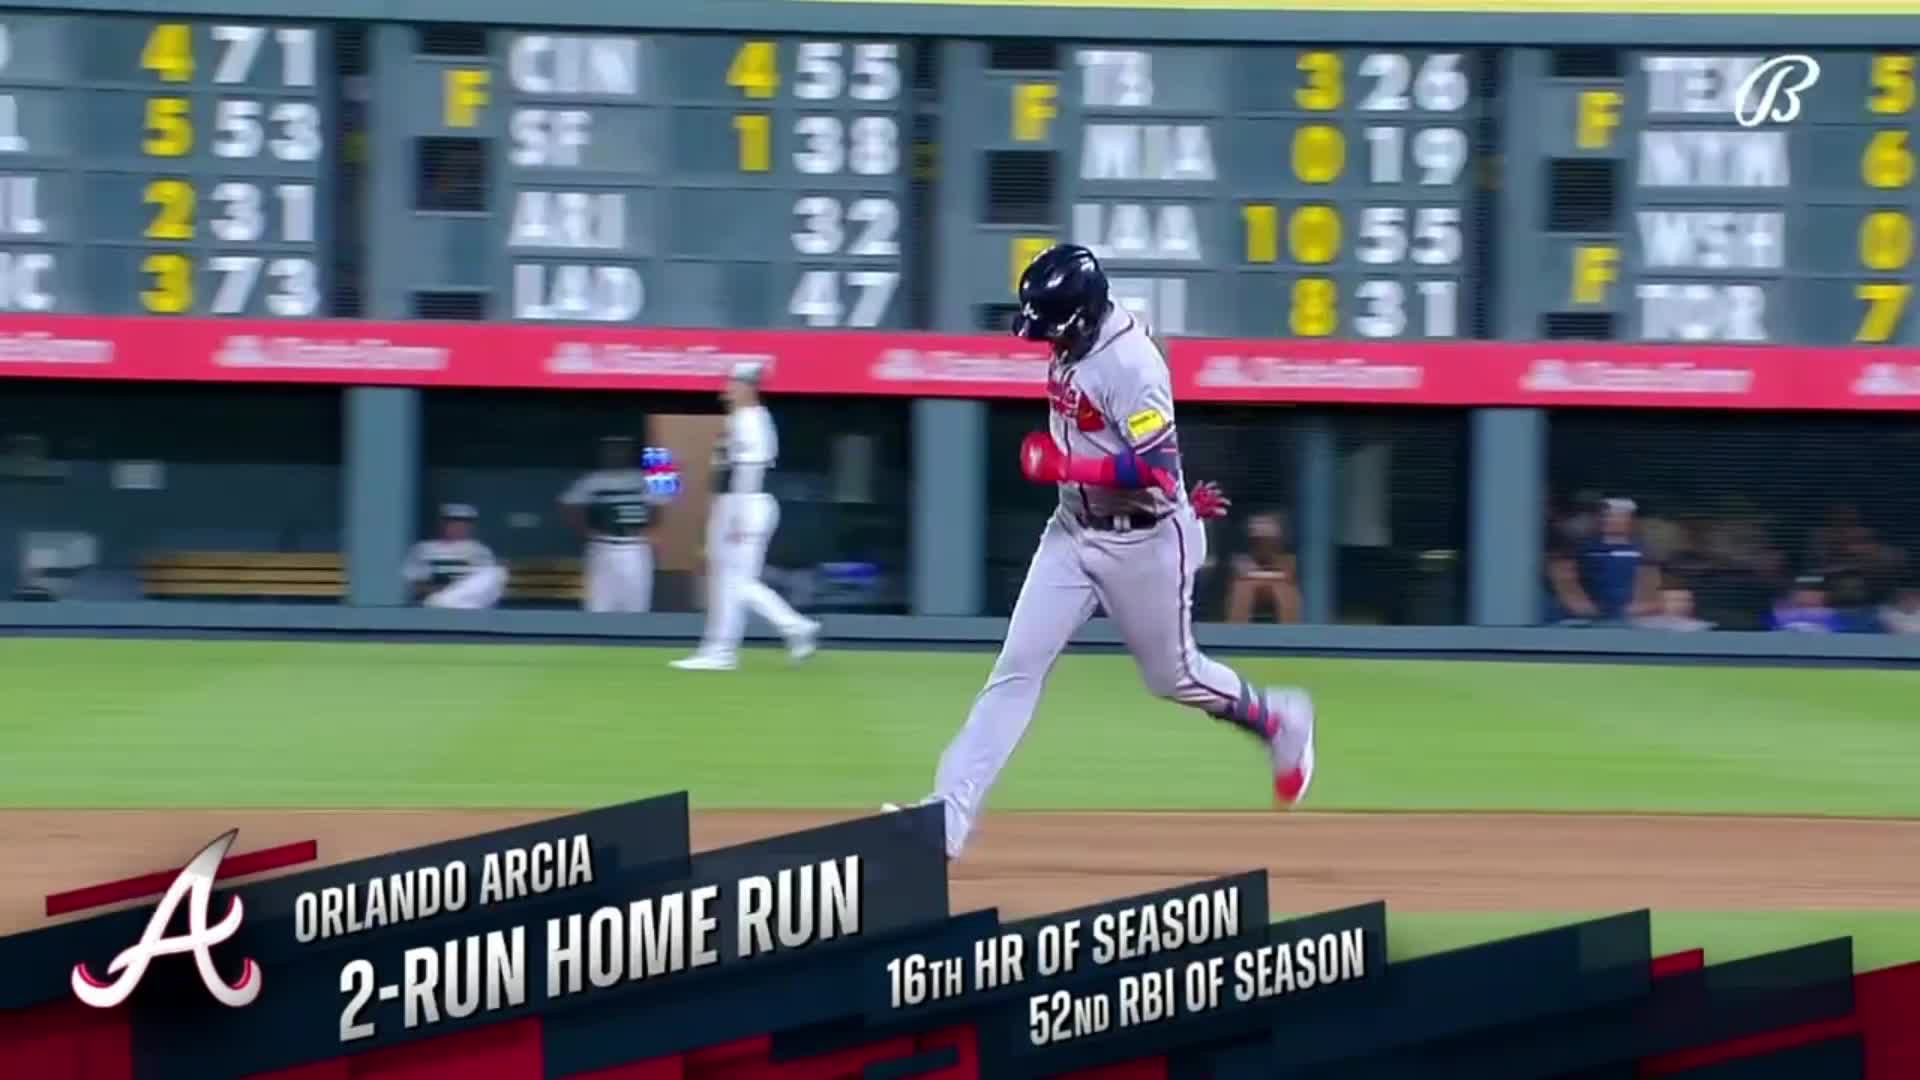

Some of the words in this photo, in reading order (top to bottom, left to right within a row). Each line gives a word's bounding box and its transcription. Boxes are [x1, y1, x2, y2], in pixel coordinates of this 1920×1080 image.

[140, 23, 195, 83] 4
[210, 26, 316, 87] 71
[725, 41, 780, 99] 4
[794, 42, 899, 101] 55
[1294, 52, 1344, 111] 3
[1356, 53, 1469, 112] 26
[1866, 56, 1916, 113] 5
[443, 69, 491, 128] F
[1011, 82, 1058, 141] F
[1576, 91, 1624, 150] F
[141, 98, 194, 157] 5
[210, 100, 324, 161] 53
[508, 109, 593, 166] SF
[732, 115, 771, 172] 1
[792, 116, 900, 175] 38
[1291, 124, 1346, 184] 0
[1362, 126, 1469, 185] 19
[1862, 131, 1914, 189] 6
[142, 180, 197, 240] 2
[209, 183, 316, 242] 31
[790, 196, 900, 255] 32
[1240, 205, 1343, 264] 10
[1354, 208, 1464, 265] 55
[1860, 212, 1914, 270] 0
[138, 254, 195, 314] 3
[208, 256, 322, 317] 73
[513, 264, 645, 322] LAD
[788, 271, 901, 328] 47
[1572, 247, 1622, 304] F
[1289, 278, 1339, 337] 8
[1354, 280, 1459, 338] 31
[1853, 284, 1913, 344] 7
